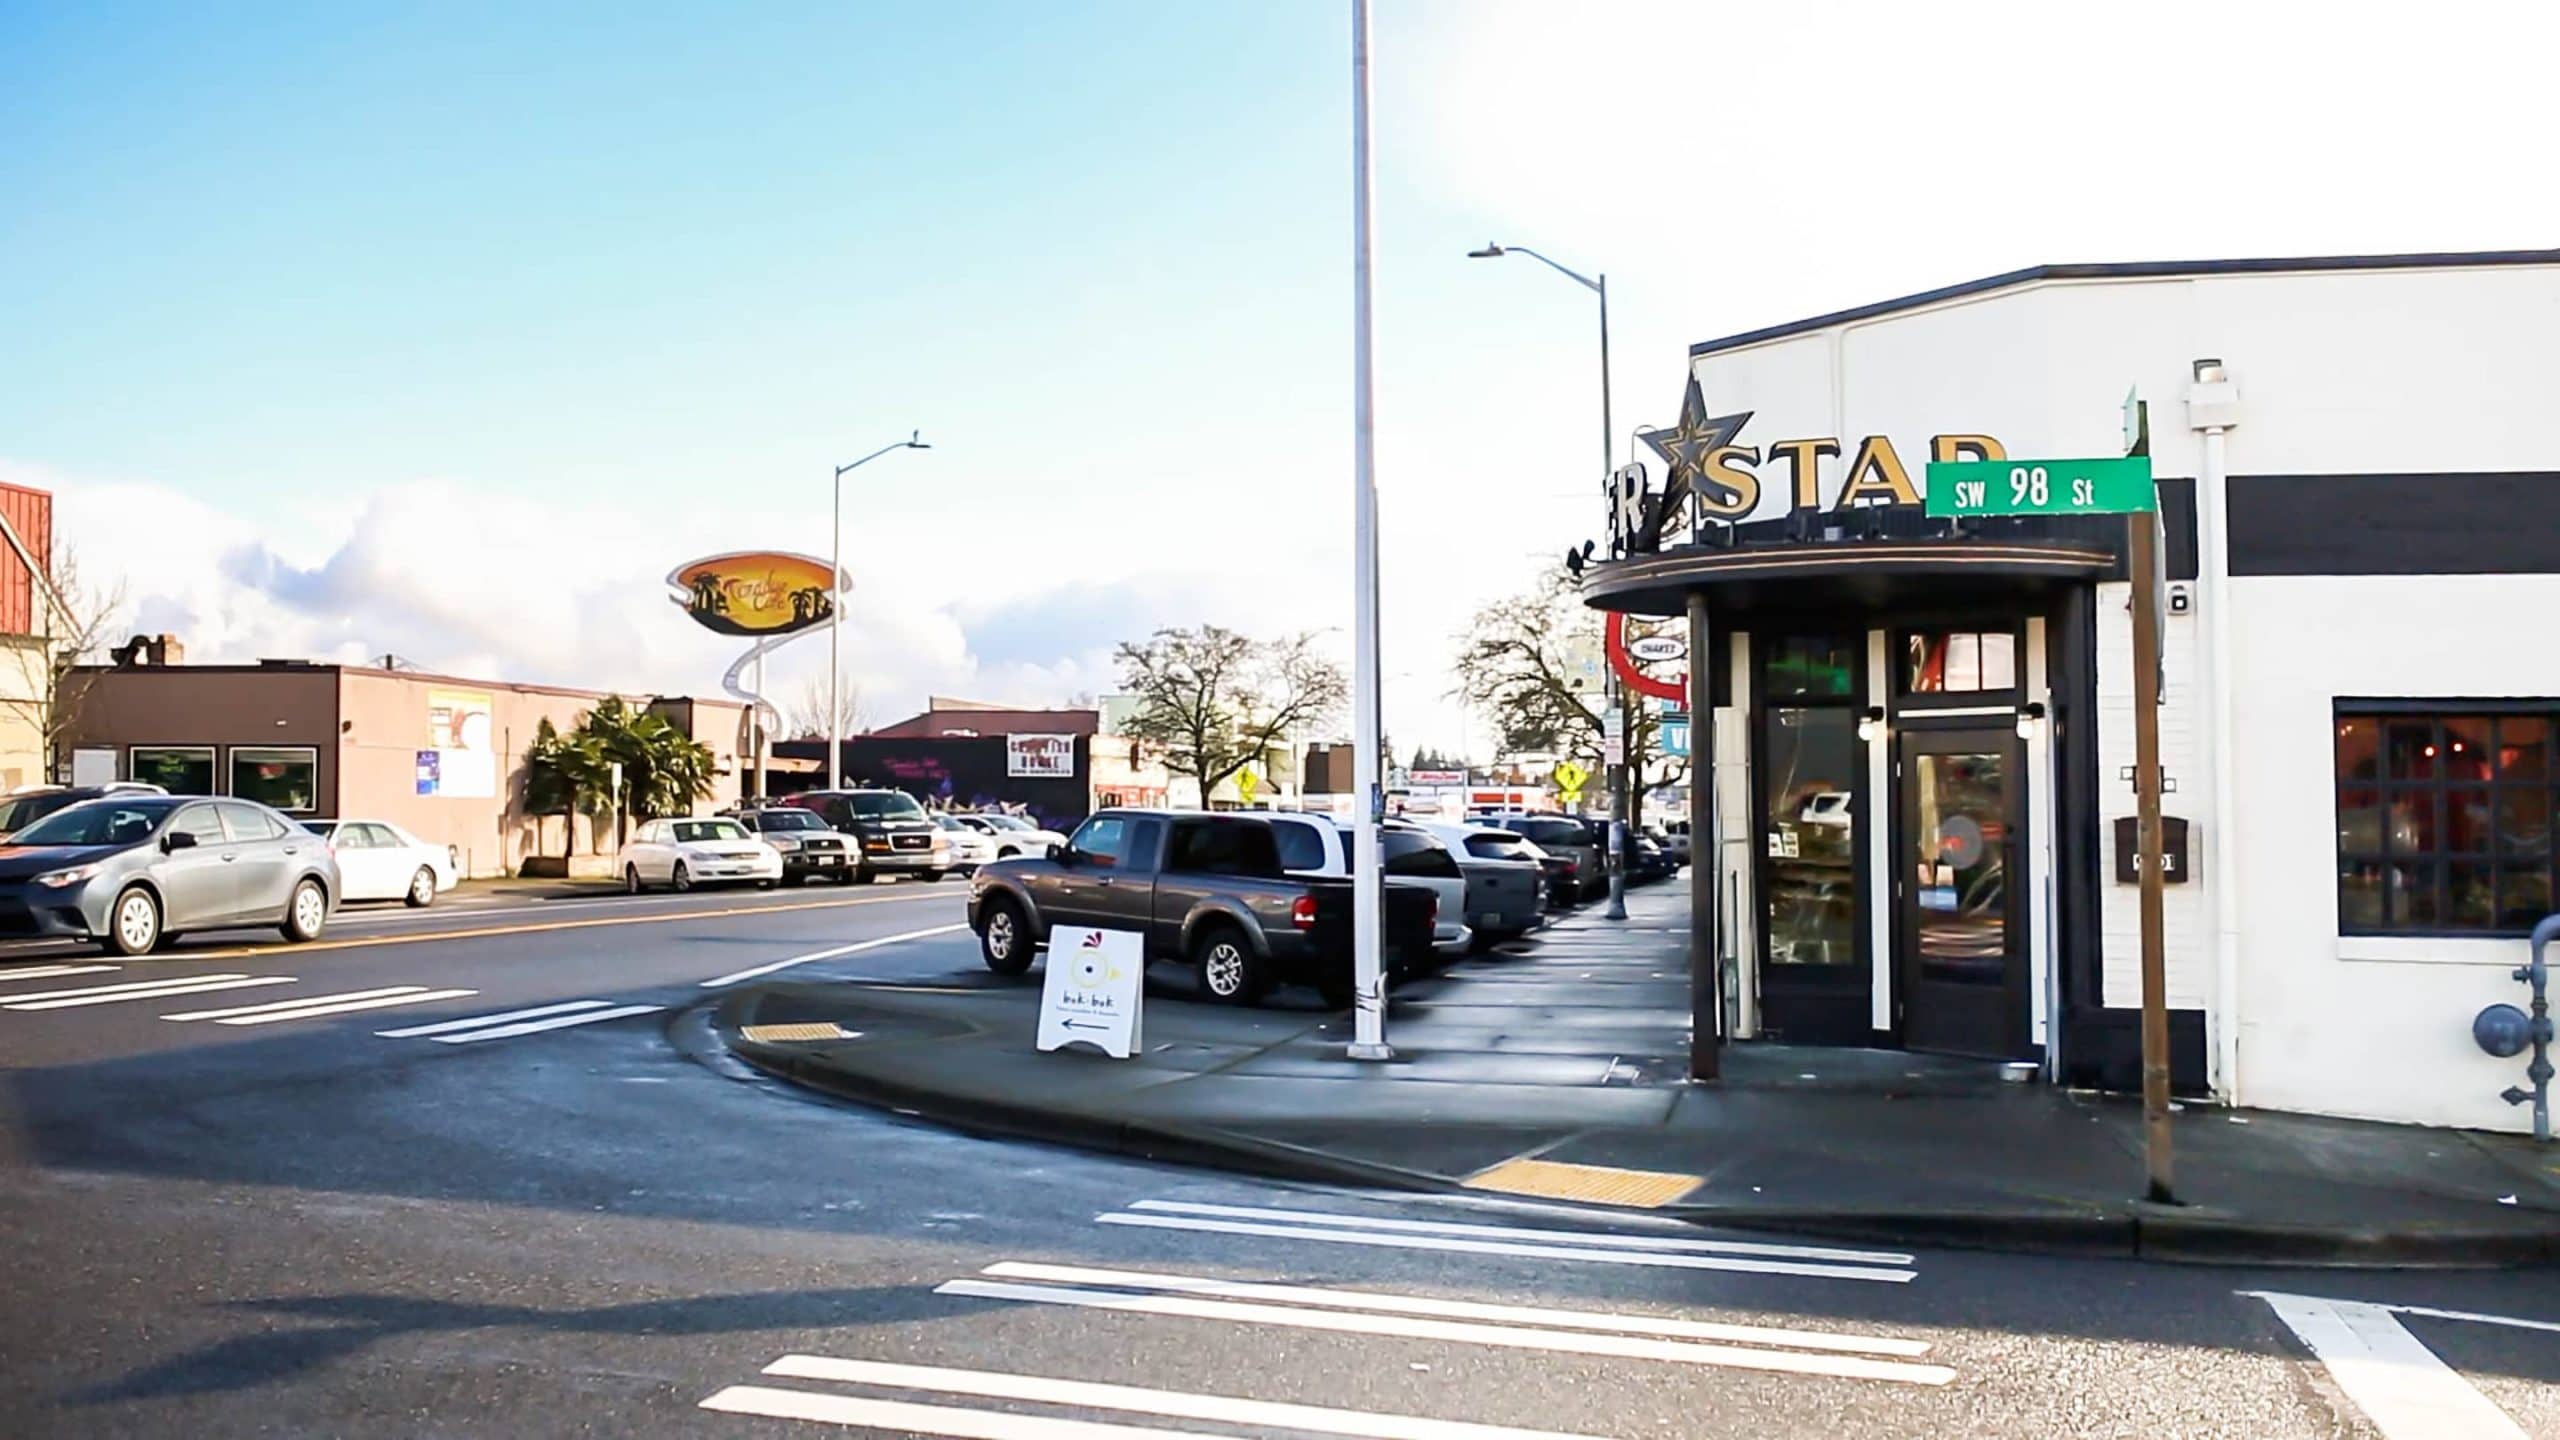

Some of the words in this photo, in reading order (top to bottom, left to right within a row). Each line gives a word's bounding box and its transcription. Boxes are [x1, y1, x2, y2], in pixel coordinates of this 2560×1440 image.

[1955, 481, 1986, 508] SW
[2010, 467, 2049, 506] 98
[2071, 479, 2095, 506] St
